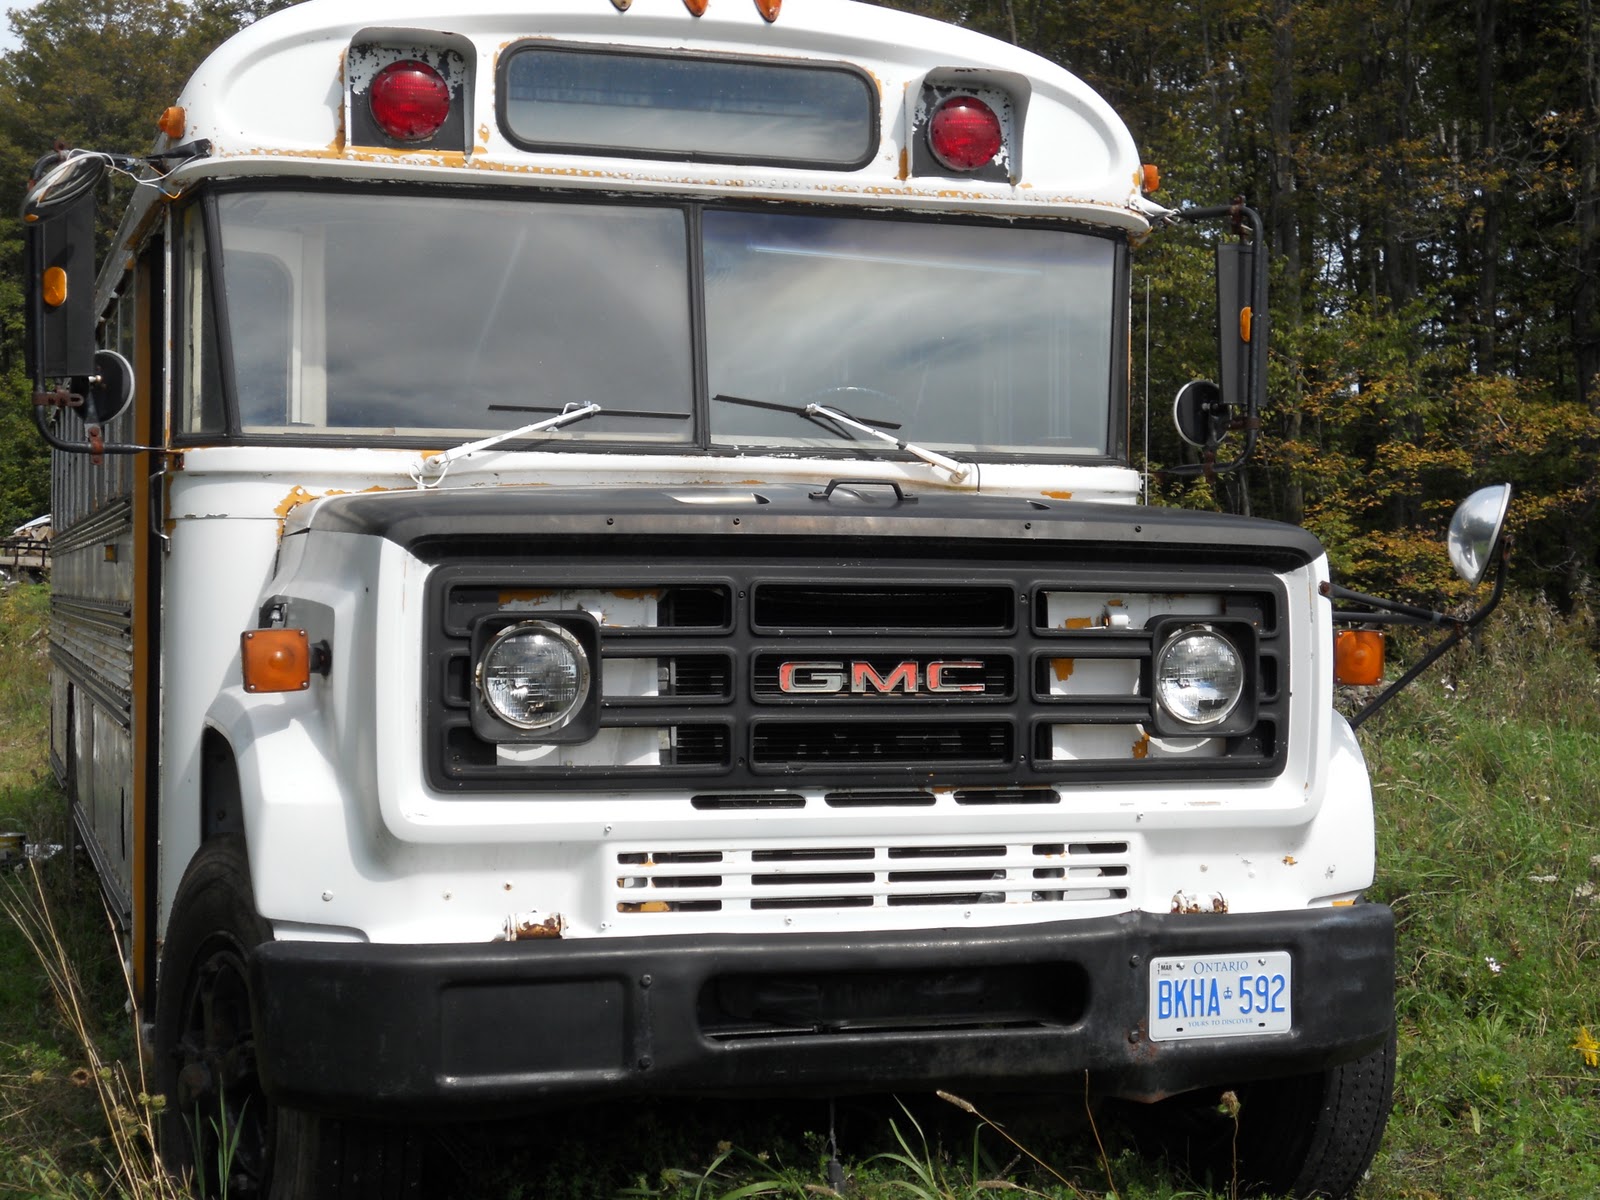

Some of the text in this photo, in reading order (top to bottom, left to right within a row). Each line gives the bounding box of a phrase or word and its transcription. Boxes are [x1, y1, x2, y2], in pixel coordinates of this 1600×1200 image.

[779, 660, 985, 693] GMC
[1193, 961, 1249, 975] ONTARIO
[1158, 974, 1286, 1020] BKHA 592
[1188, 1020, 1209, 1028] YOURS
[1221, 1017, 1254, 1026] DISCOVER
